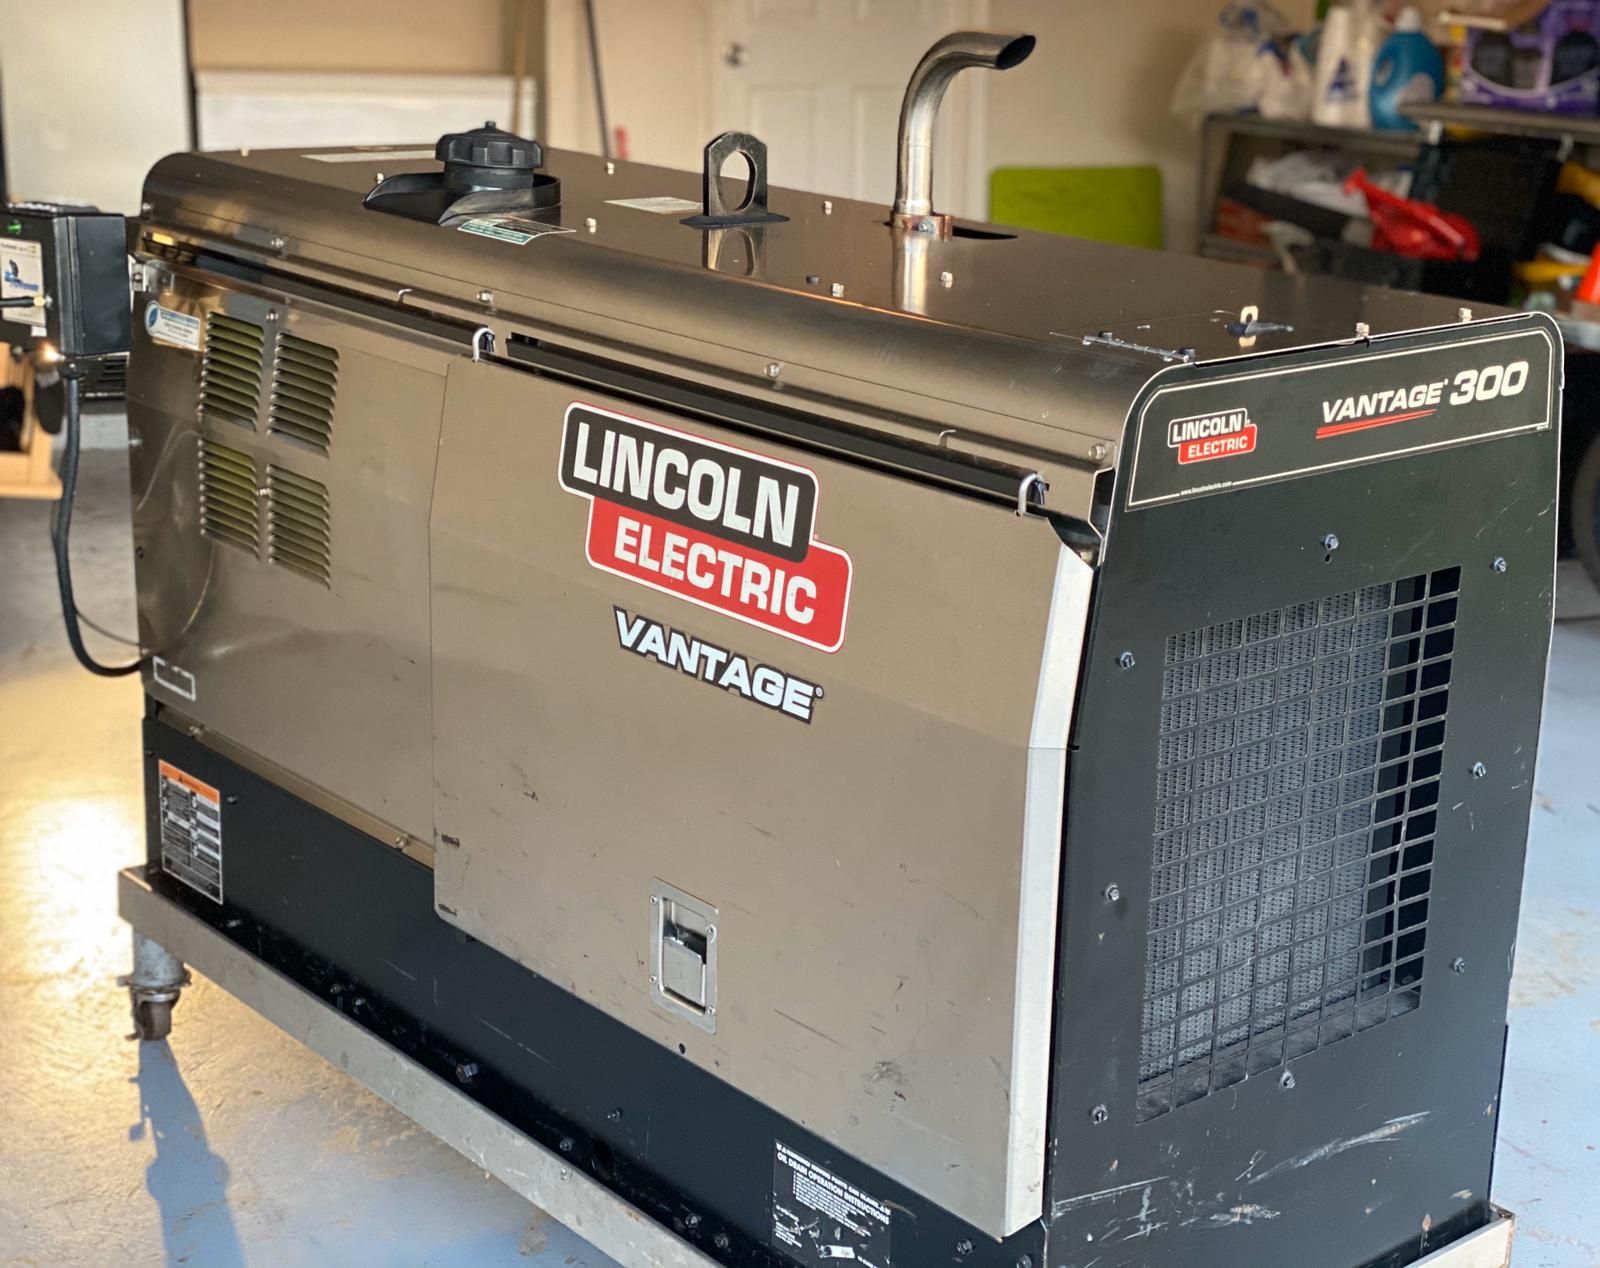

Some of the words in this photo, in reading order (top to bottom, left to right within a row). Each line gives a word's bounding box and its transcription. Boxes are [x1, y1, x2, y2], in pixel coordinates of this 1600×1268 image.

[1172, 413, 1242, 442] LINCOLN
[1322, 381, 1444, 423] VANTAGE
[1450, 361, 1529, 406] 300
[1188, 436, 1248, 458] ELECTRIC
[573, 422, 799, 547] LINCOLN
[614, 516, 816, 625] ELECTRIC
[614, 607, 816, 721] VANTAGE
[777, 1152, 788, 1164] OIL
[788, 1158, 807, 1176] DRAIN
[808, 1170, 843, 1198] OPERATION
[844, 1191, 889, 1225] INSTRUCTIONS
